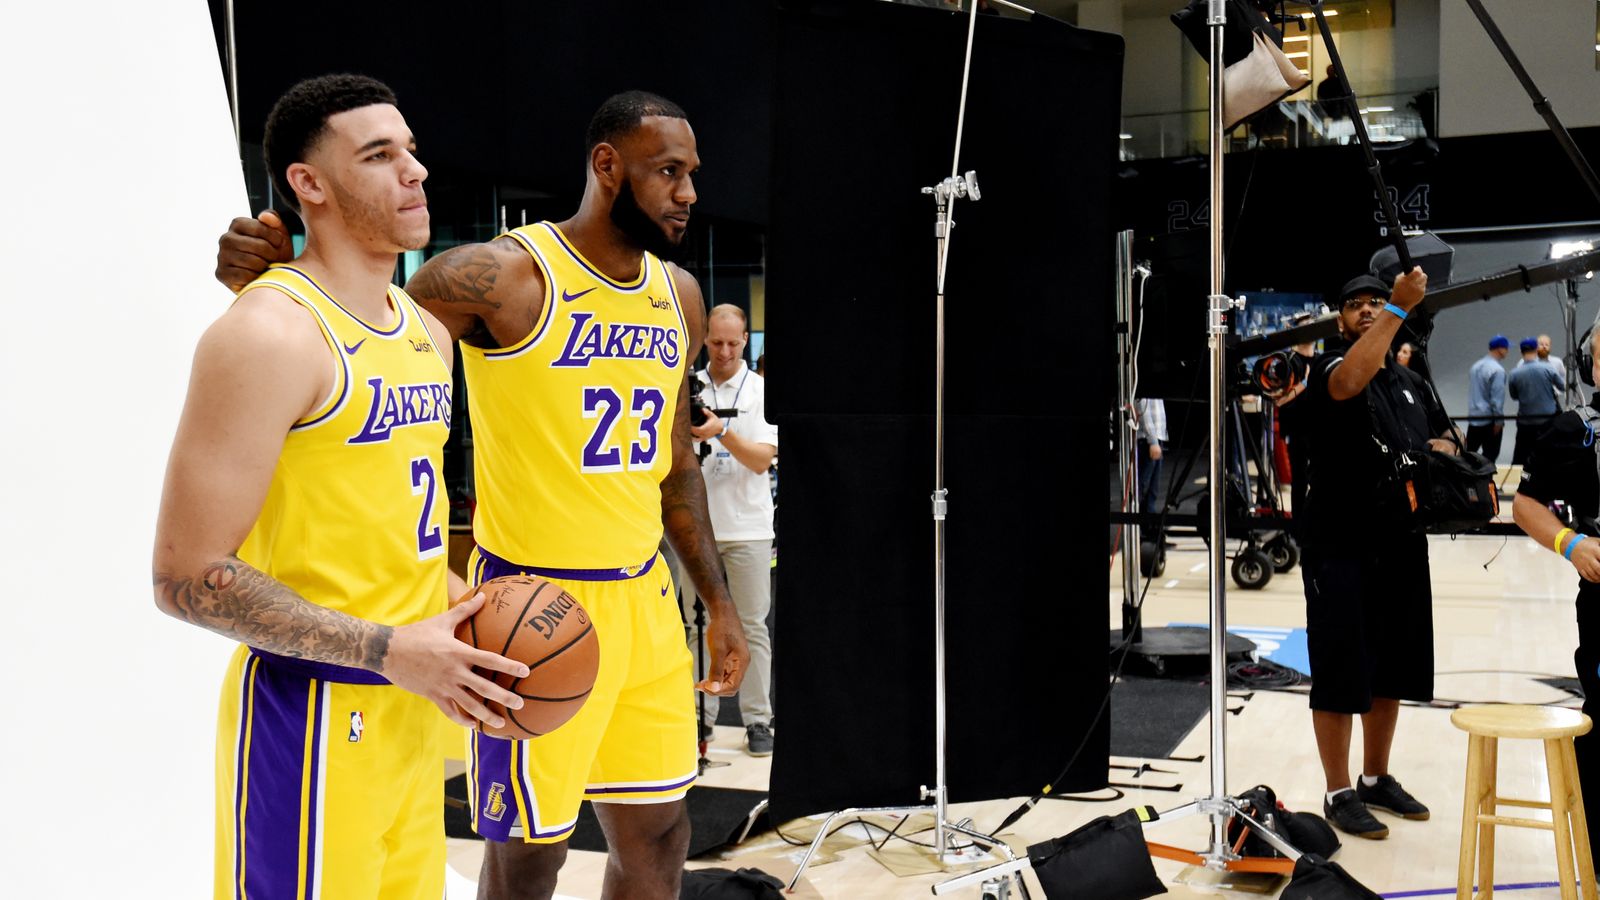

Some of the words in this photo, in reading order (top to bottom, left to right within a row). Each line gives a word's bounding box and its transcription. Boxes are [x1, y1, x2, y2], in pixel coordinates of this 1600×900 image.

[549, 312, 680, 369] LAKERS
[345, 376, 452, 445] LAKERS
[580, 385, 665, 474] 23
[410, 457, 444, 561] 2
